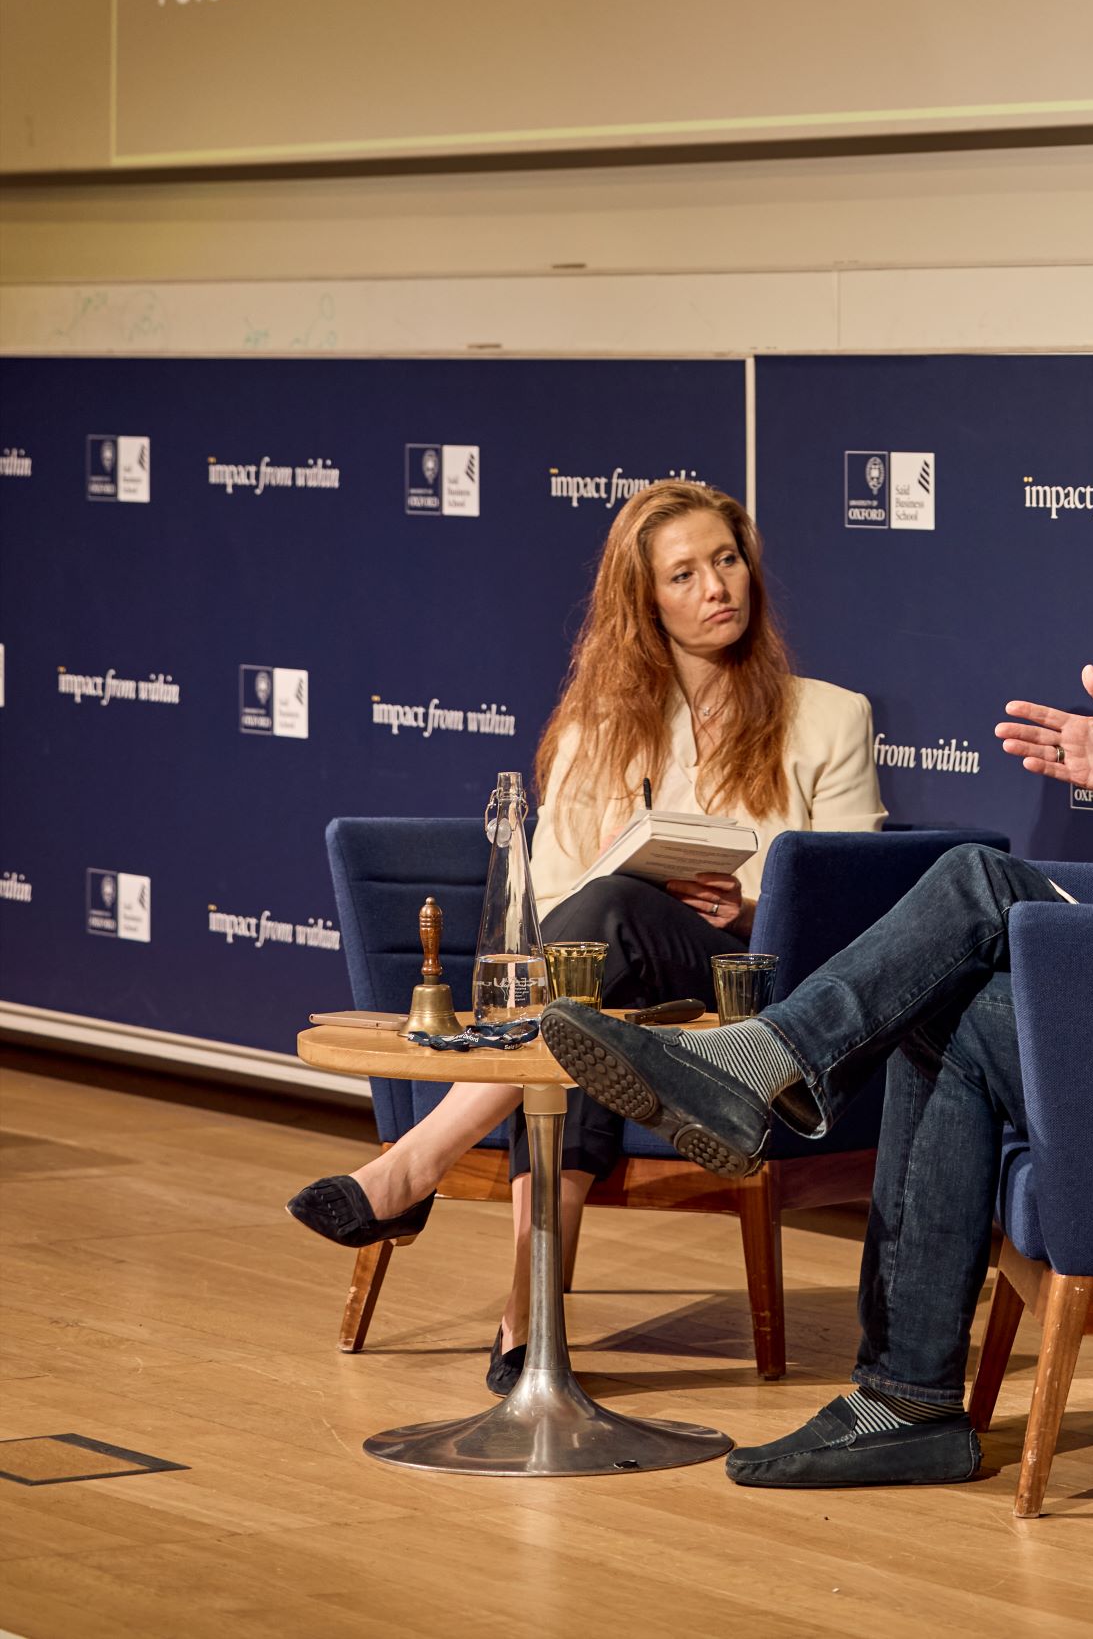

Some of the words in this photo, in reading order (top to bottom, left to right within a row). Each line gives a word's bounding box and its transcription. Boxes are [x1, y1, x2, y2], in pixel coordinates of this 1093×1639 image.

[254, 456, 293, 495] from
[295, 458, 340, 489] within
[422, 698, 465, 738] from
[467, 703, 516, 737] within
[873, 733, 917, 769] from
[920, 738, 980, 774] within
